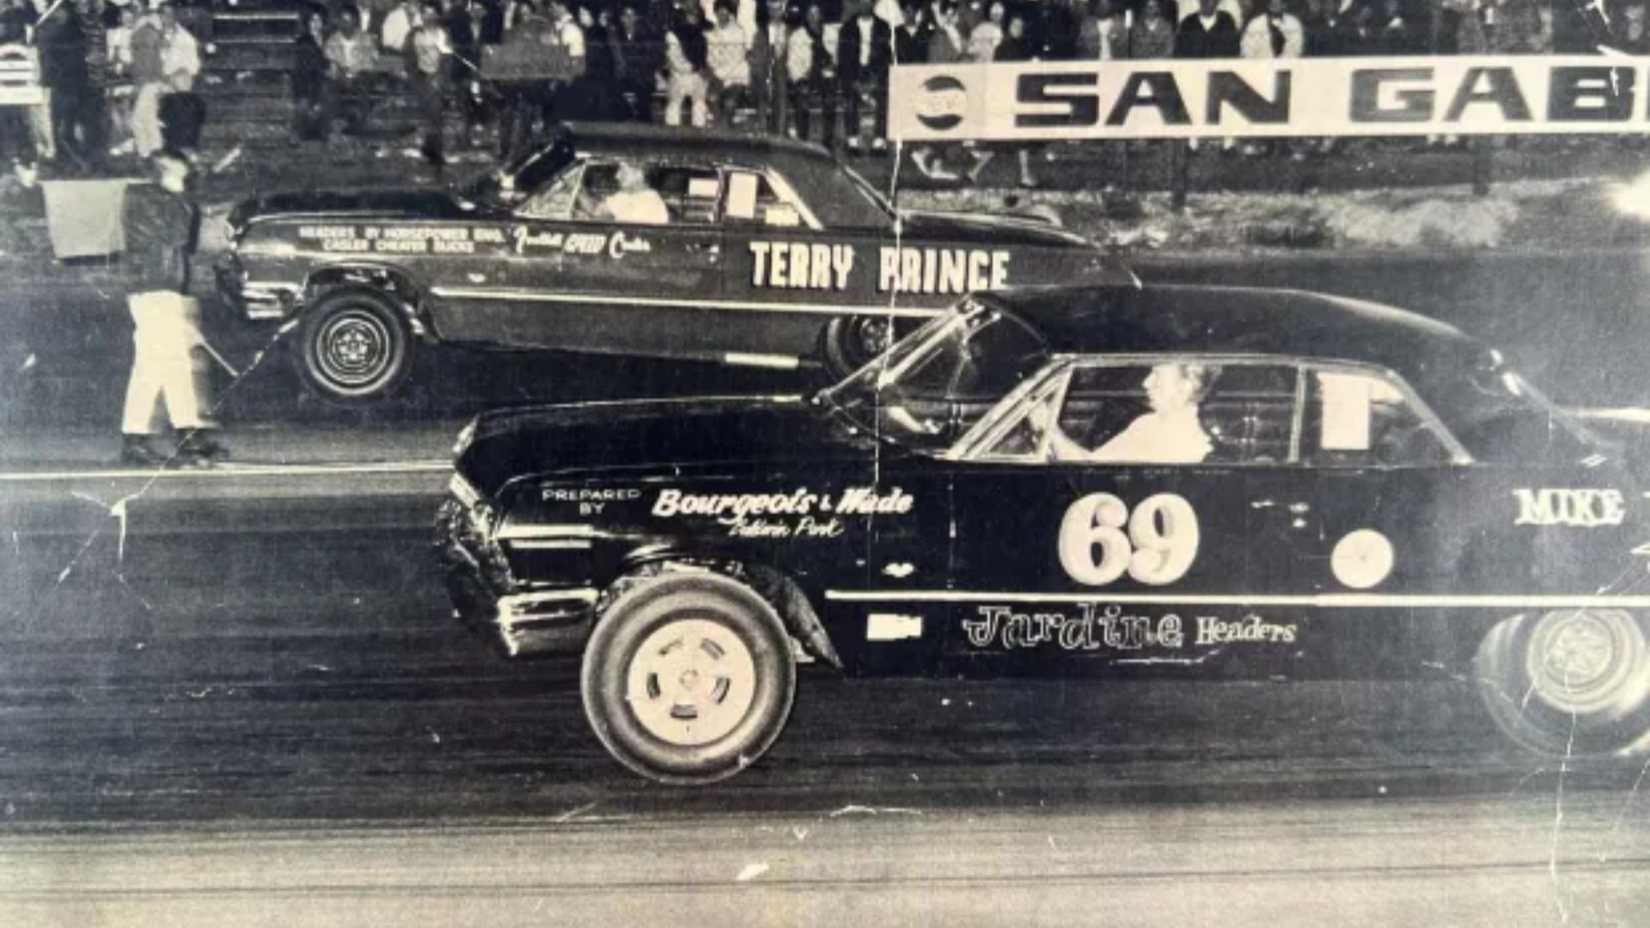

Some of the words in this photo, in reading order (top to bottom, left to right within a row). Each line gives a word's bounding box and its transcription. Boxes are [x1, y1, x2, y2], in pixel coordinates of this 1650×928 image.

[1014, 70, 1291, 127] SAN
[1349, 66, 1650, 122] GAB
[749, 241, 855, 290] TERRY
[879, 246, 1010, 294] PRINCE
[541, 488, 642, 502] PREPARED
[579, 501, 606, 515] BY
[1511, 487, 1626, 528] MIKE
[1057, 490, 1199, 587] 69
[962, 602, 1184, 651] Jardine
[1195, 613, 1298, 645] Headers
